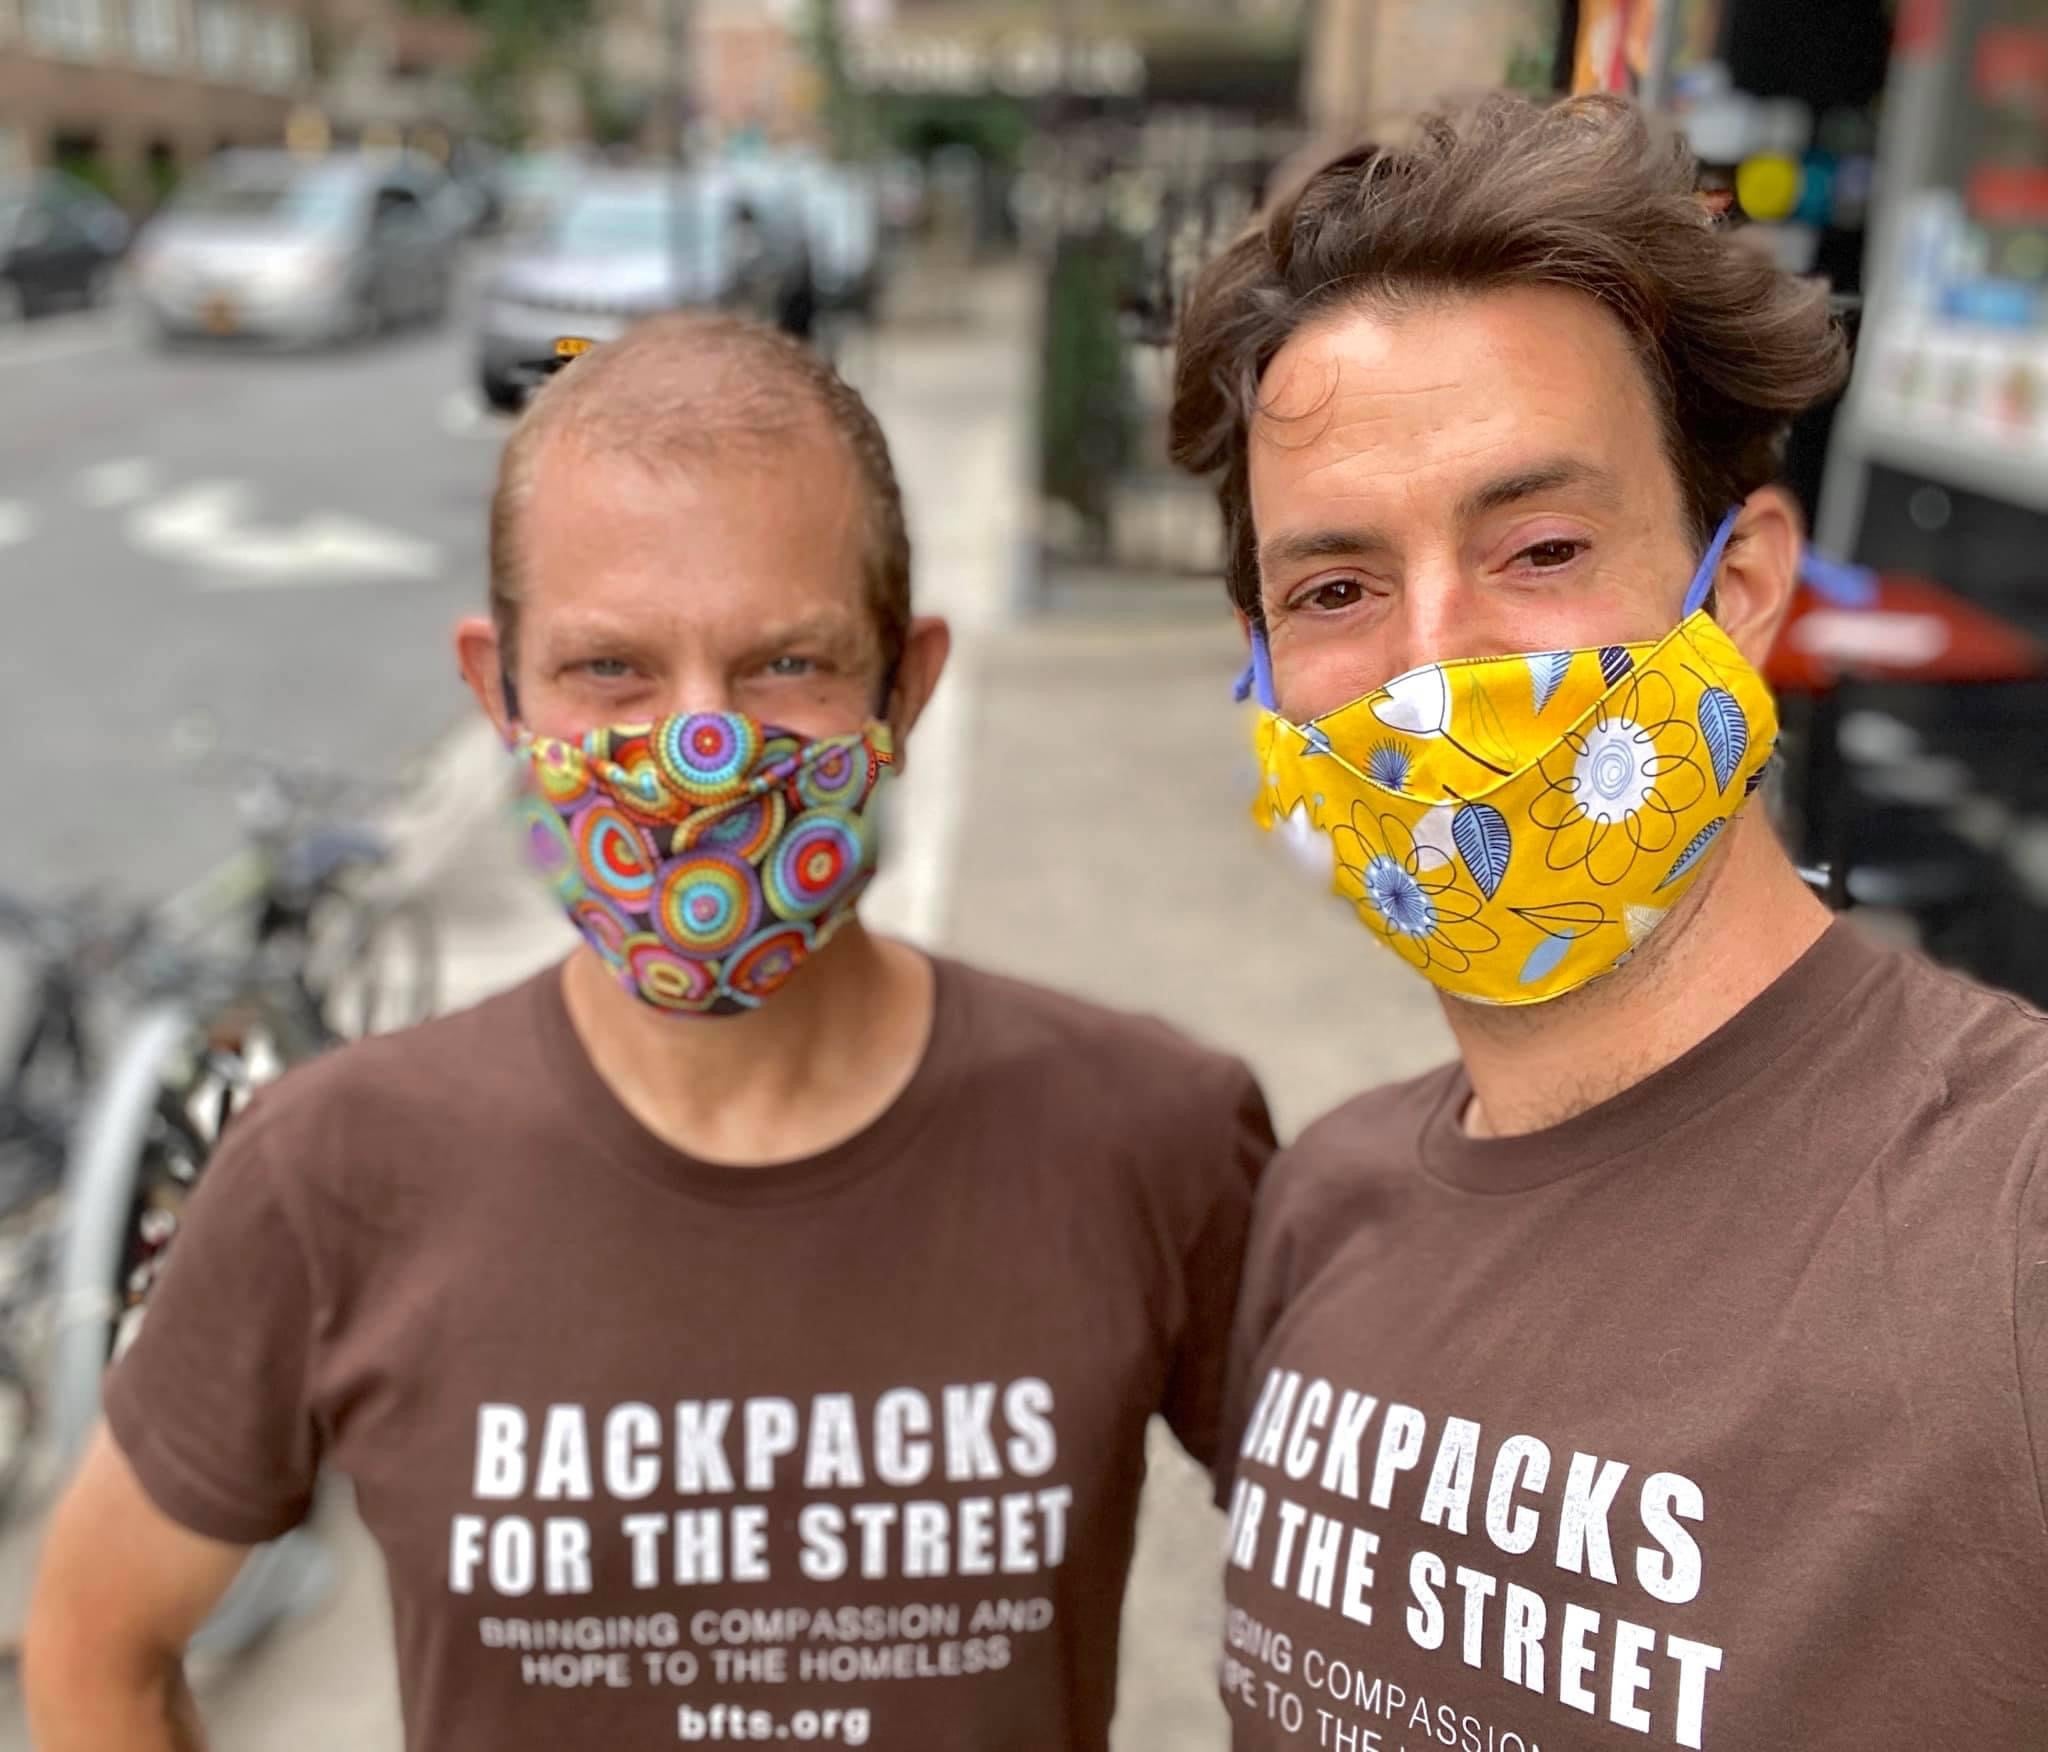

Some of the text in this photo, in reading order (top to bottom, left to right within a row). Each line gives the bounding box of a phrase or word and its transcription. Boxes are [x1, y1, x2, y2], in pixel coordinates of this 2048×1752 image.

[472, 1376, 1057, 1499] BACKPACKS
[449, 1486, 1072, 1595] FOR THE STREET
[479, 1597, 1054, 1650] BRINGING COMPASSION AND
[1271, 1499, 1381, 1626] THE
[1406, 1551, 1723, 1750] STREET
[521, 1634, 1011, 1688] HOPE TO THE HOMELESS
[677, 1703, 871, 1746] bfts.org
[1263, 1679, 1304, 1734] TO
